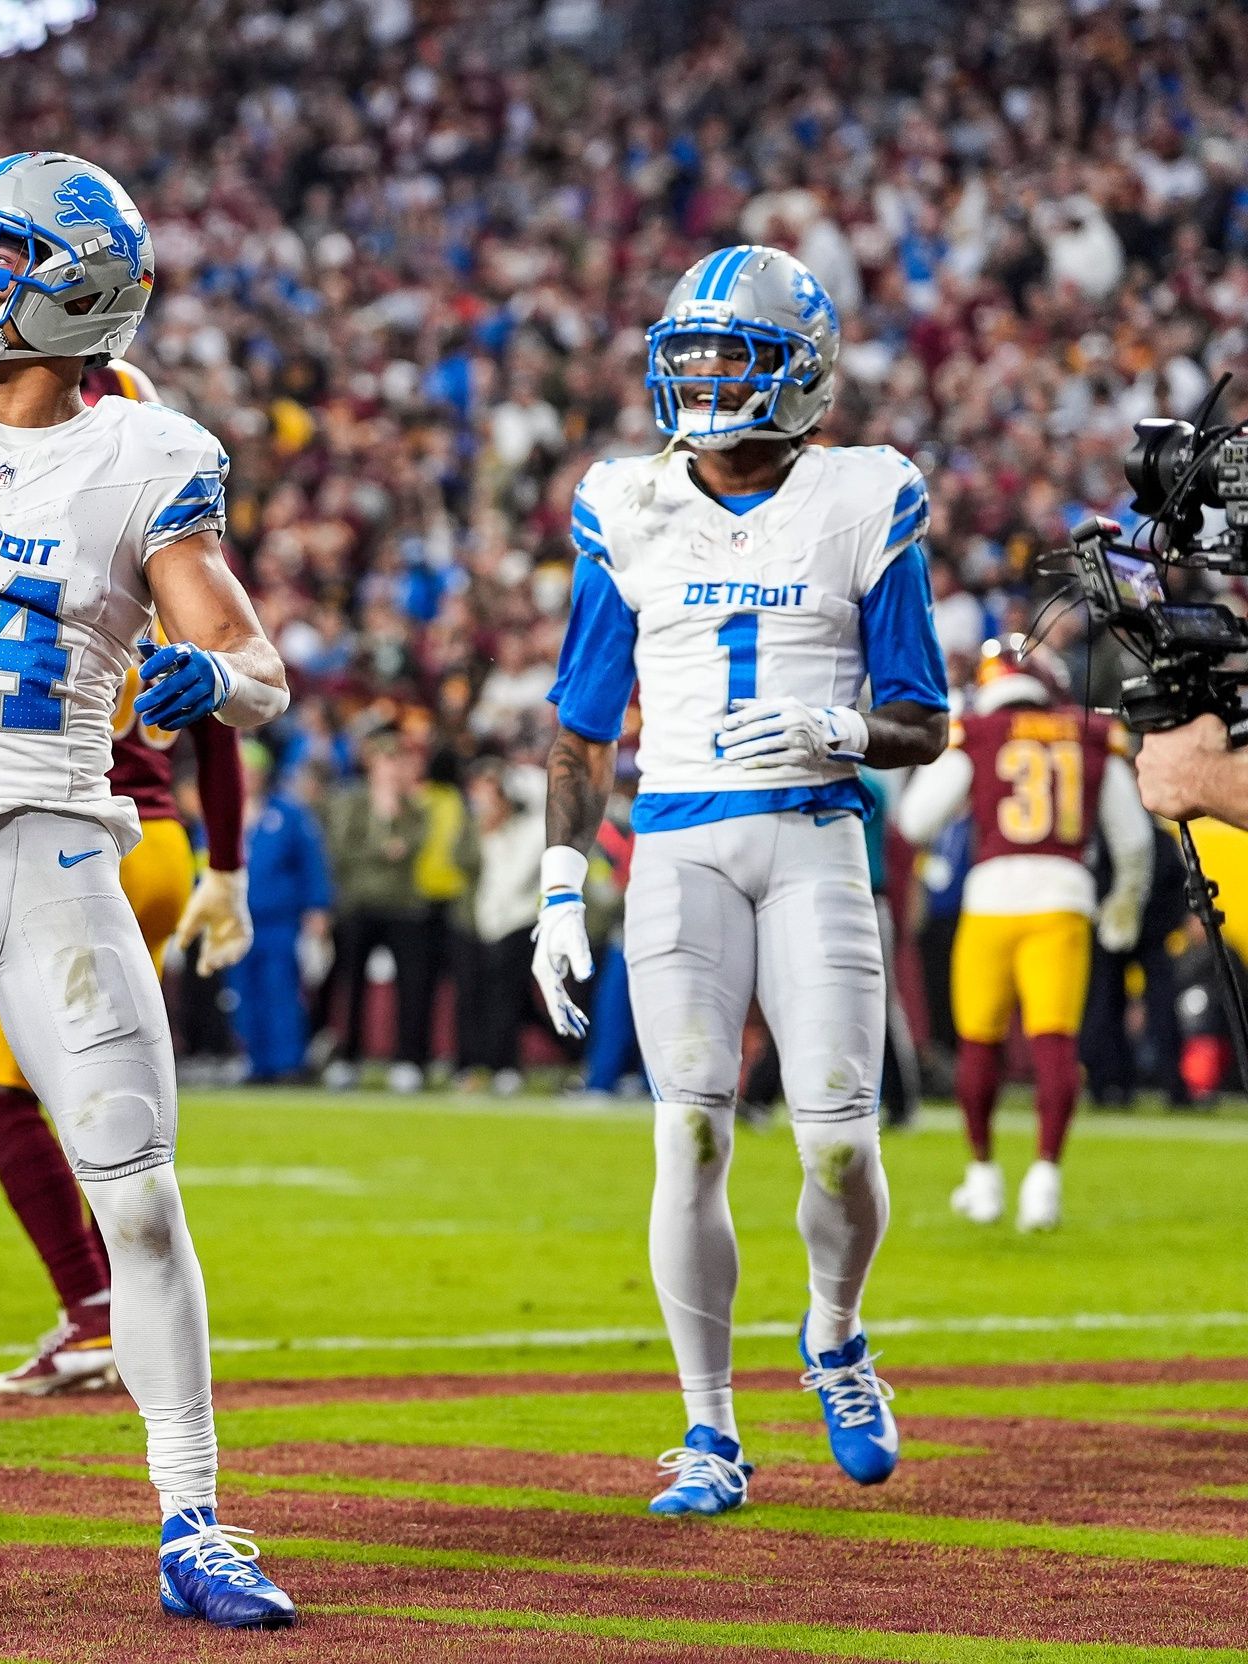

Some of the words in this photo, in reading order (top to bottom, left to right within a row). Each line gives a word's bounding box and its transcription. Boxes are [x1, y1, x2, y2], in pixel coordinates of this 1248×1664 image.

[683, 582, 808, 607] DETROIT
[716, 612, 759, 759] 1
[995, 738, 1084, 844] 31
